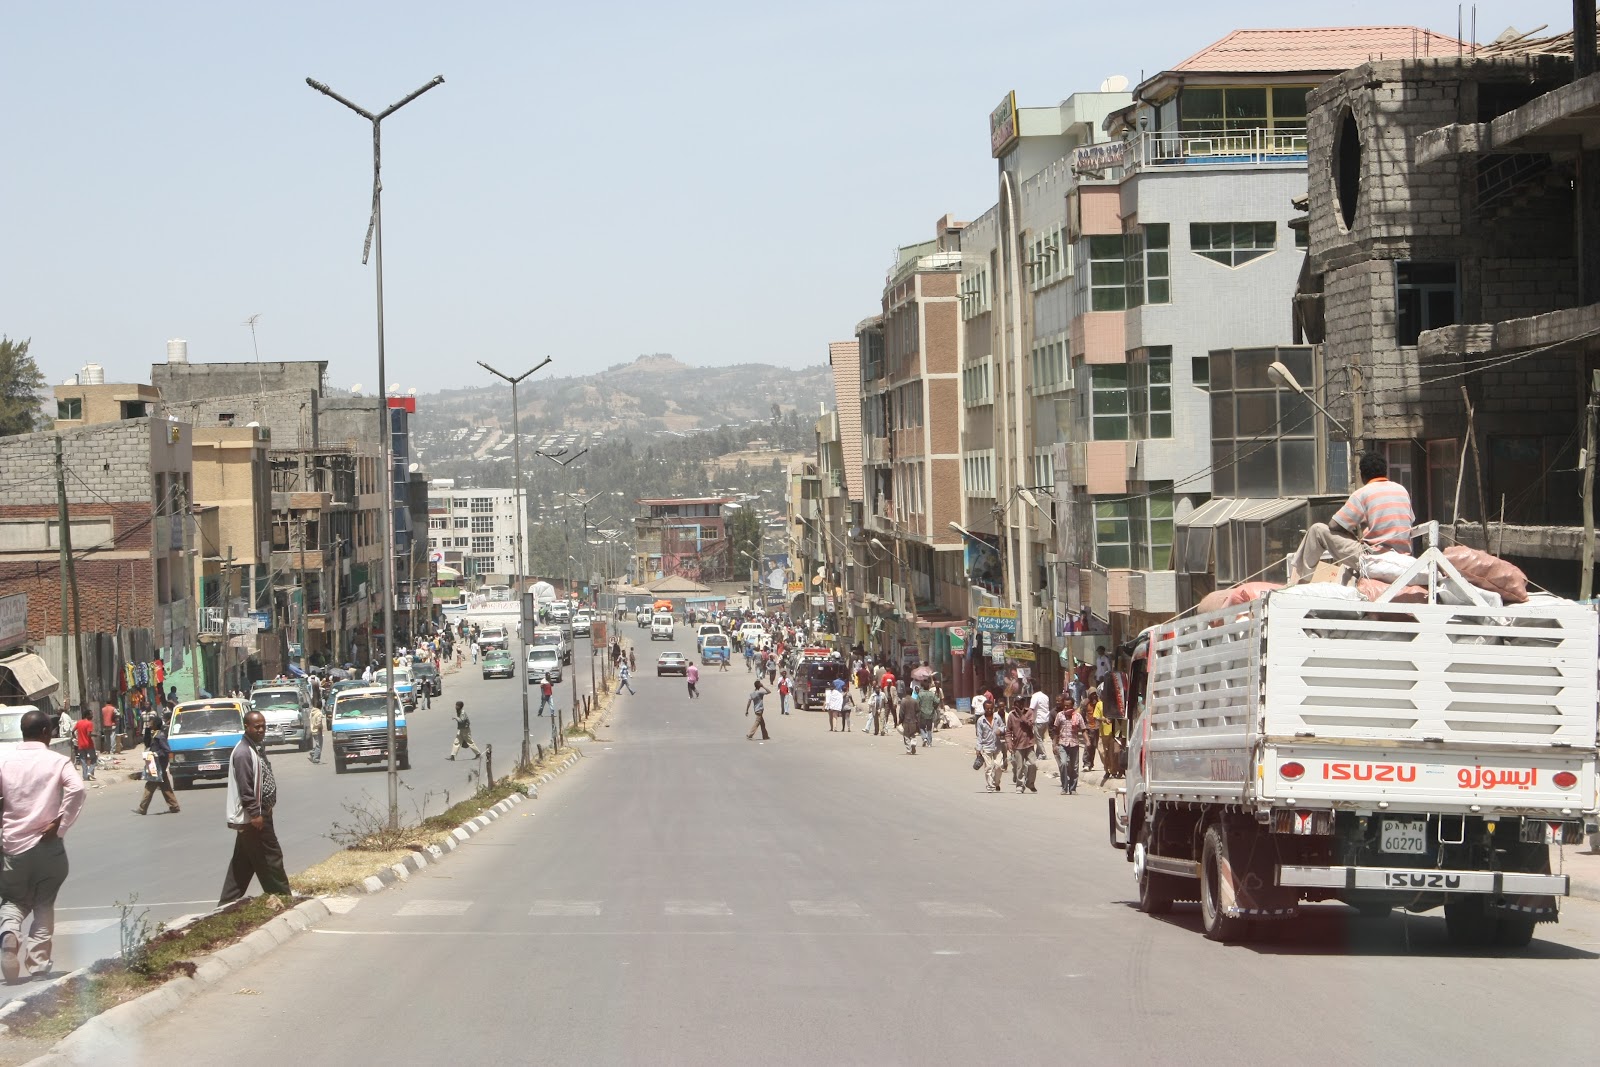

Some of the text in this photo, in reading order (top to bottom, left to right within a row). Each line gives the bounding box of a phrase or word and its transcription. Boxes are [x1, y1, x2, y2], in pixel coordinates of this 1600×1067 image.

[1322, 763, 1416, 782] ISUZU
[1457, 765, 1537, 790] ايسوزو
[1385, 837, 1423, 851] 60270
[1386, 873, 1460, 888] ISUZU
